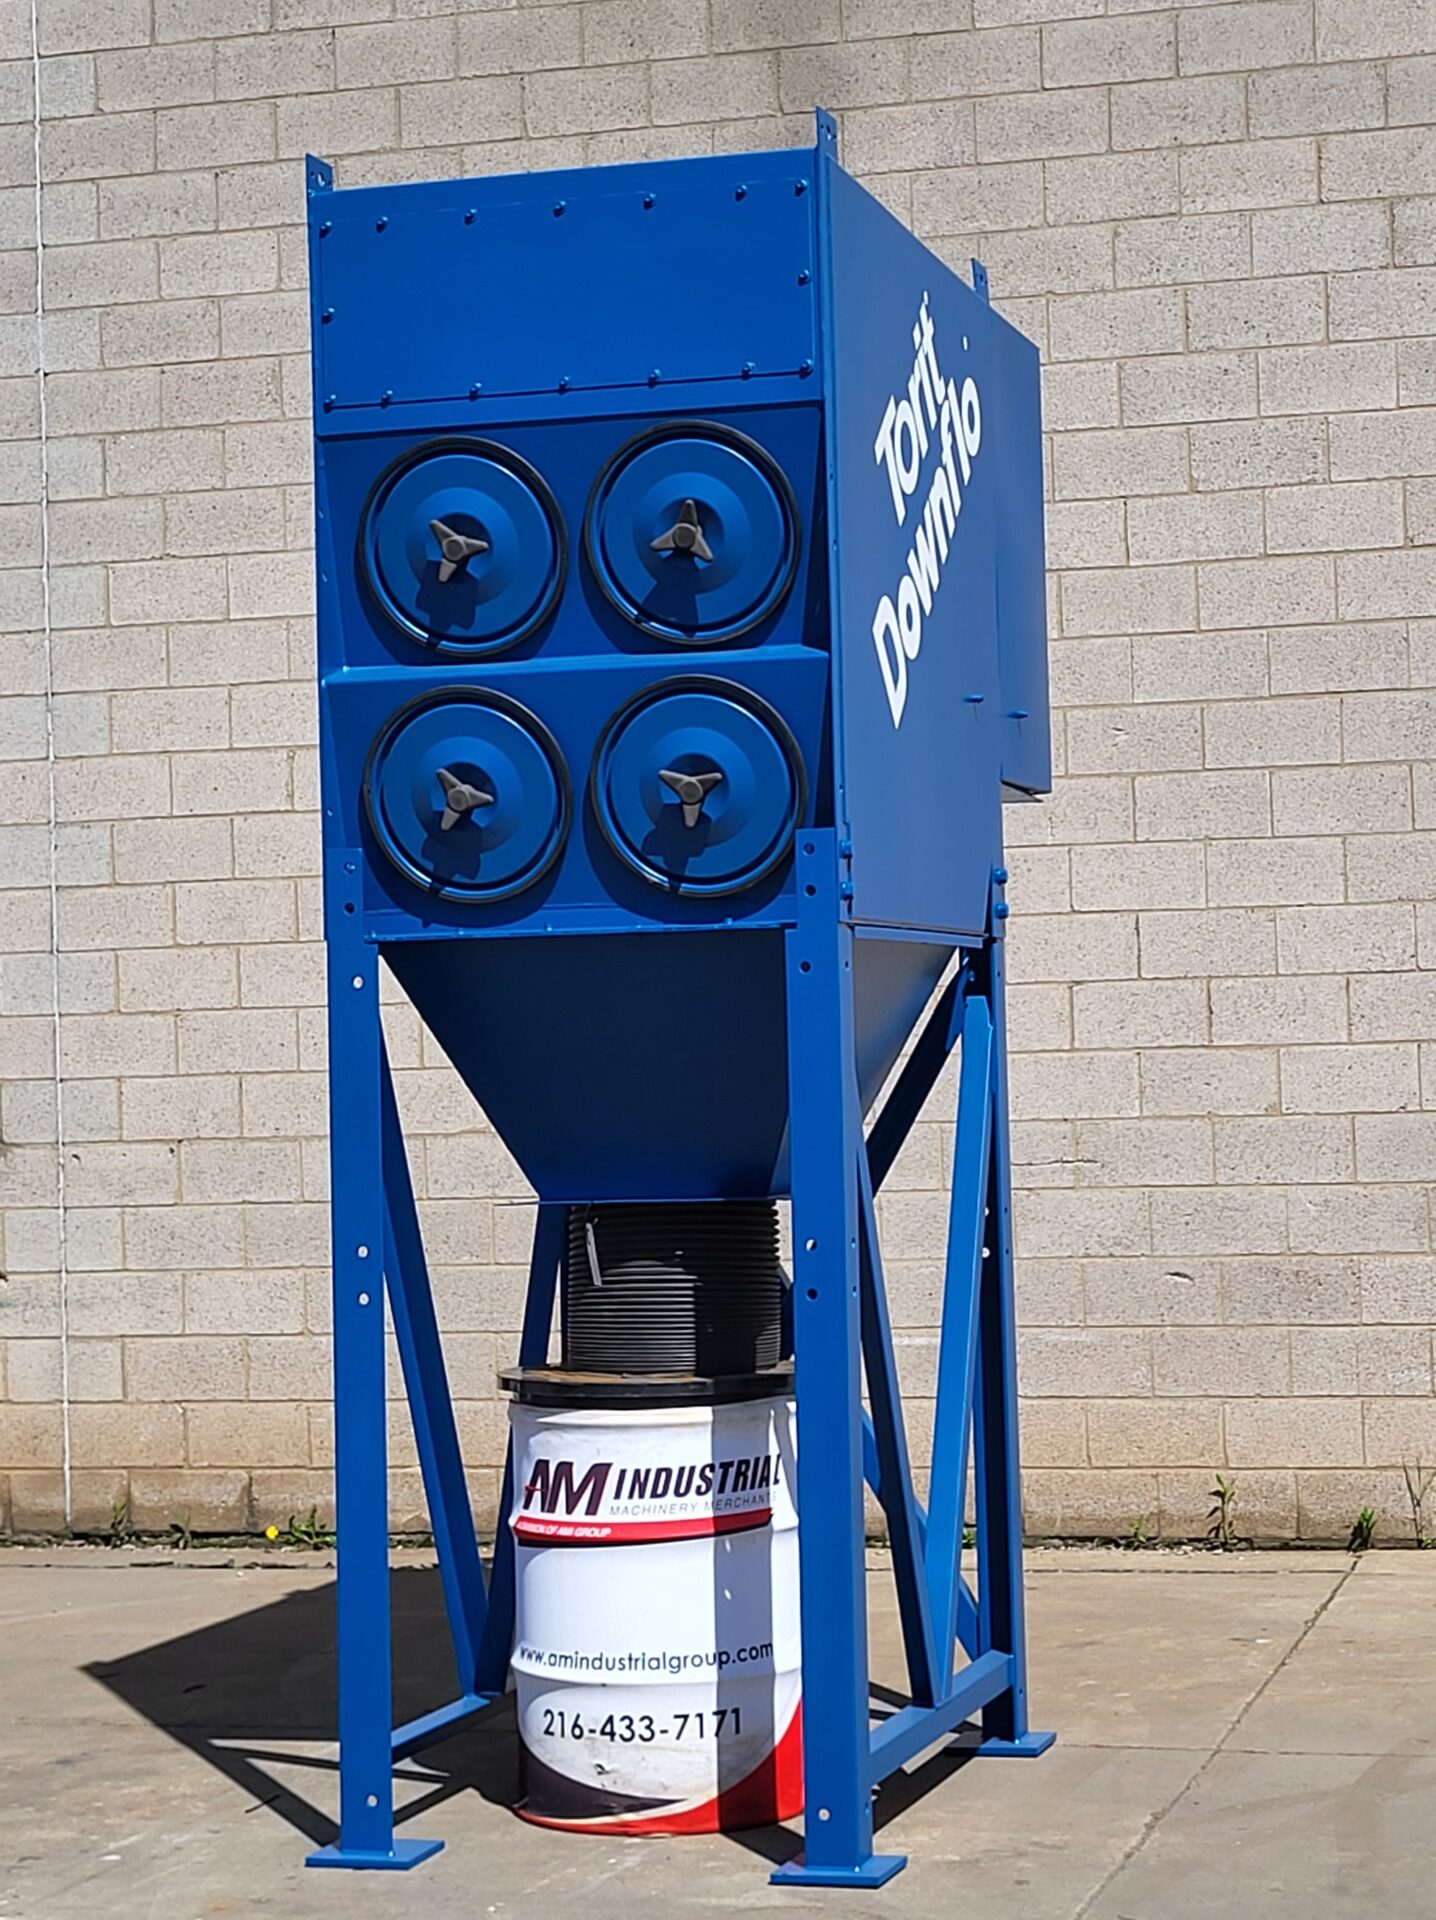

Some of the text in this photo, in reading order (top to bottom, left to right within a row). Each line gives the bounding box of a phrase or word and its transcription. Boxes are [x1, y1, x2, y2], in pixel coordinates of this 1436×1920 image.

[874, 301, 946, 527] Torit
[872, 377, 980, 729] Downflo
[522, 1453, 781, 1516] AM INDUSTRIAL
[610, 1499, 699, 1516] MACHINERY
[574, 1527, 612, 1538] GROUP
[520, 1643, 773, 1674] www.amindustrialgroup.com
[543, 1707, 741, 1742] 216-433-7171
